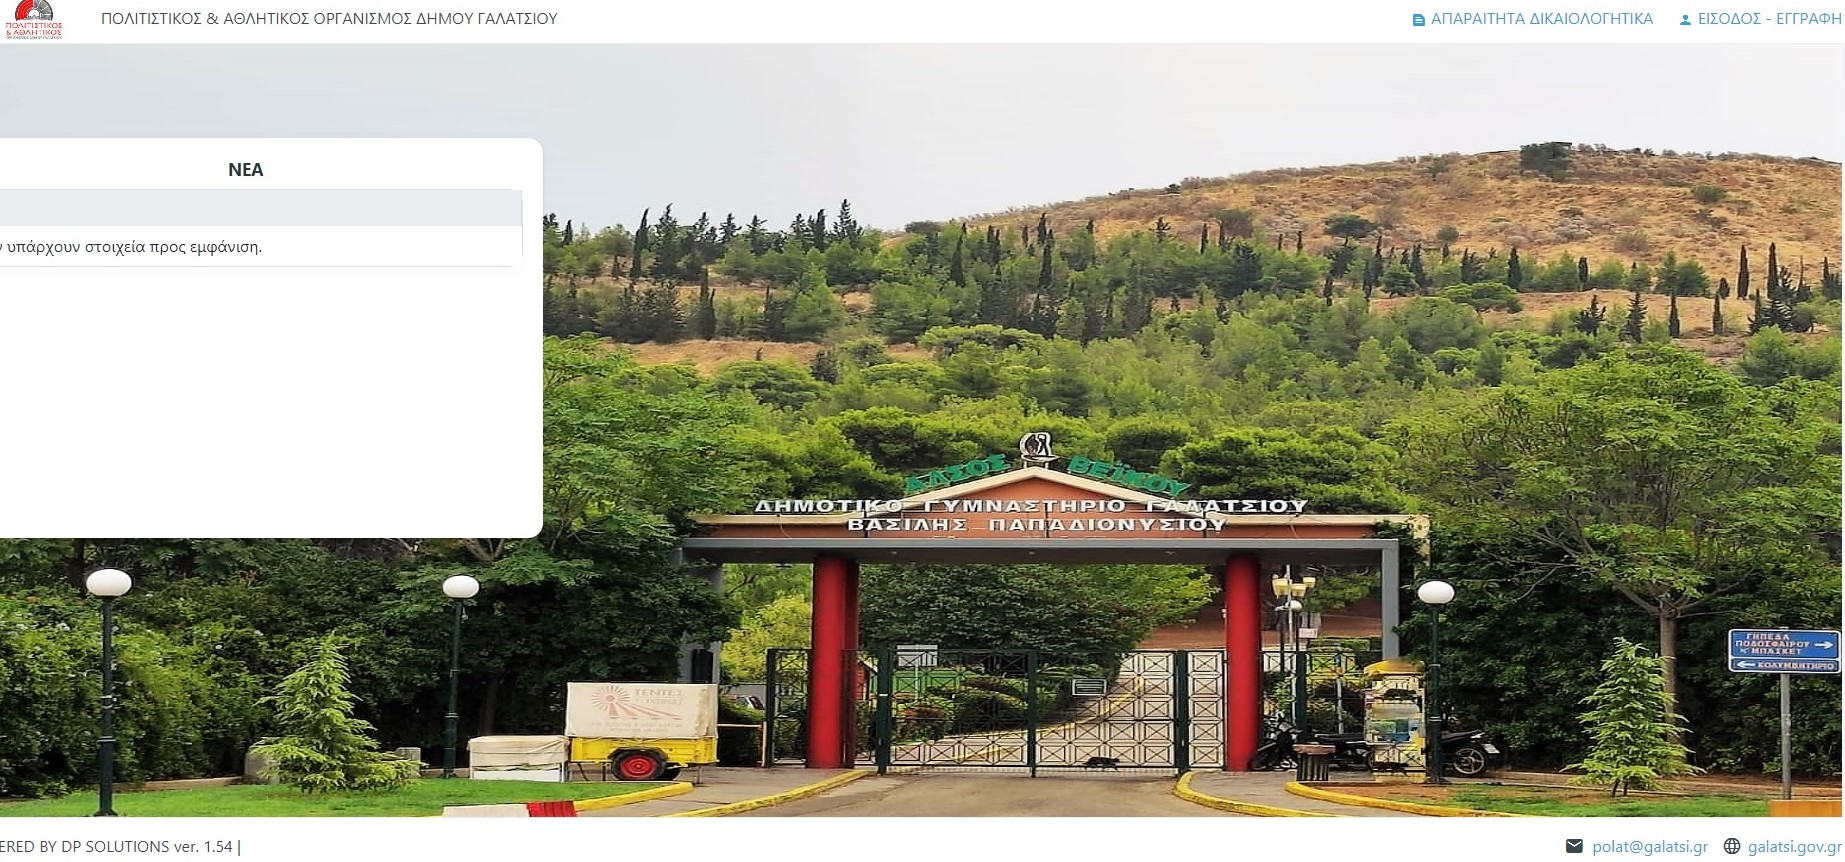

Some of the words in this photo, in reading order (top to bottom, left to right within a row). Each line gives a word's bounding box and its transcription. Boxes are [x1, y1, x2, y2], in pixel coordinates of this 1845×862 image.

[905, 453, 1011, 494] ΑΛΣΟΣ
[755, 499, 903, 514] ΔΗΜΟΤΙΚΟ
[924, 499, 1127, 514] ΓΥΜΝΑΣΤΗΡΙΟ
[1146, 499, 1309, 514] ΓΑΛΑΤΣΙΟΥ
[848, 517, 968, 533] ΒΑΣΙΛΗΣ
[989, 517, 1227, 533] ΠΑΠΑΔΙΟΝΥΣΙΟΥ
[1735, 640, 1811, 648] ΠΟΔΟΣΦΑΙΡΟΥ
[1746, 633, 1790, 641] ΓΗΠΕΔΑ
